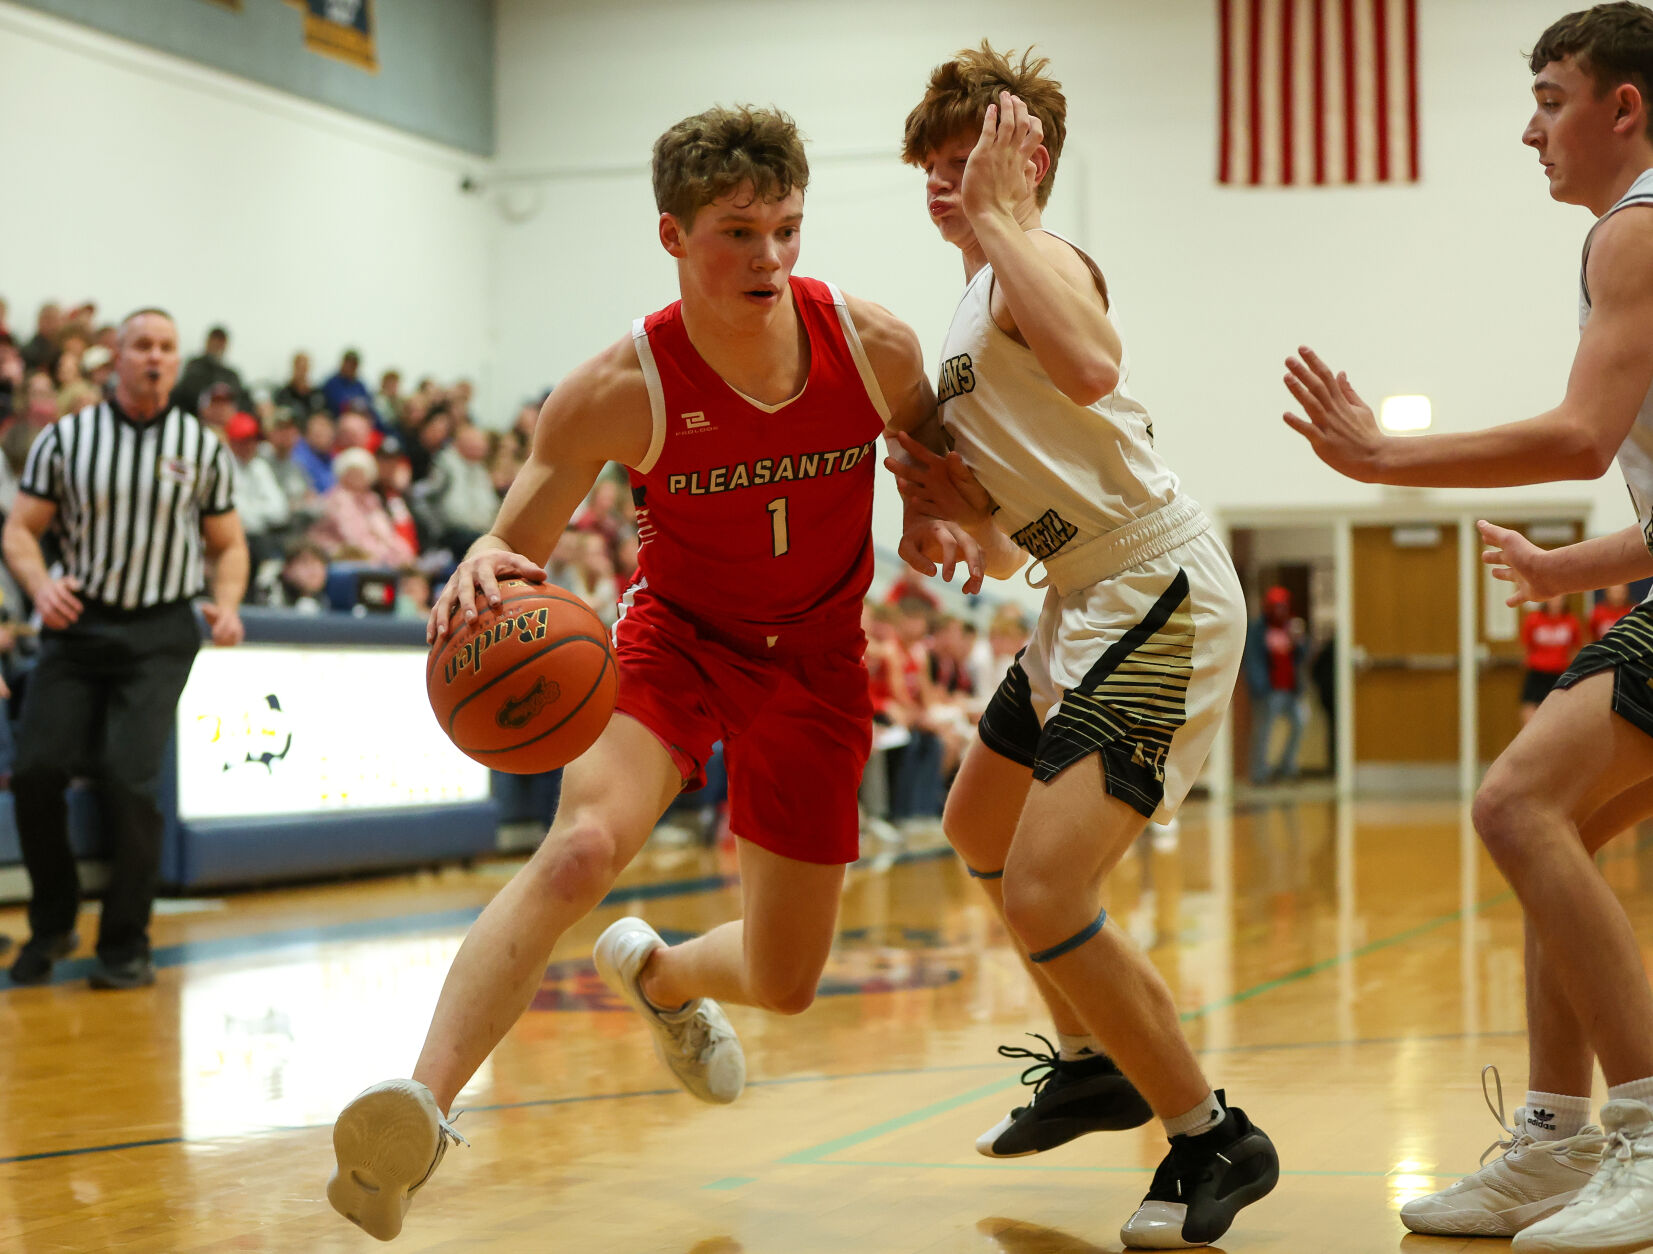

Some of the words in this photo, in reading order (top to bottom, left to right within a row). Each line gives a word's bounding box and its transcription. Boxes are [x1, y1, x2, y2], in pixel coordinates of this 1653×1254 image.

[766, 496, 789, 559] 1
[444, 607, 549, 685] Baden
[1527, 1117, 1557, 1131] adidas
